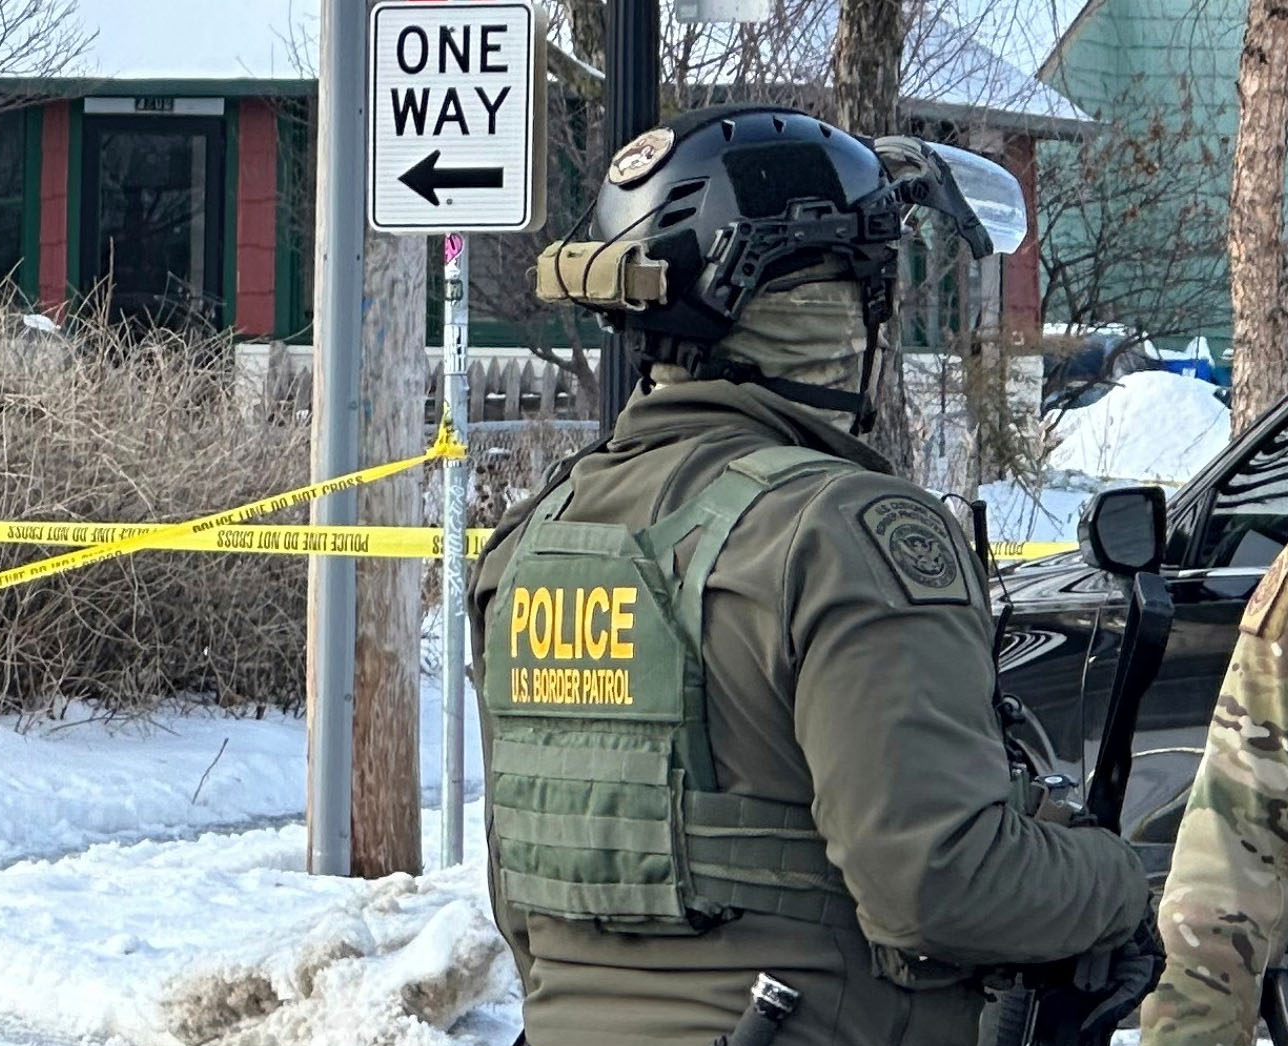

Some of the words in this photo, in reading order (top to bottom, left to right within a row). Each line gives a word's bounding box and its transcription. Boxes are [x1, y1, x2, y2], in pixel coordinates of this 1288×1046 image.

[396, 25, 508, 74] ONE
[390, 86, 512, 136] WAY
[239, 504, 266, 520] LINE
[271, 497, 289, 511] DO
[292, 488, 318, 505] NOT
[322, 475, 363, 495] CROSS
[7, 525, 44, 541] CROSS
[47, 526, 69, 541] NOT
[72, 527, 89, 542] DO
[91, 527, 117, 543] LINE
[217, 529, 254, 548] CROSS
[256, 531, 281, 548] NOT
[283, 531, 300, 550] DO
[303, 532, 328, 551] LINE
[331, 533, 369, 553] POLICE
[511, 586, 638, 660] POLICE
[512, 668, 531, 703] U.S.
[533, 668, 580, 704] BORDER
[582, 669, 634, 705] PATROL
